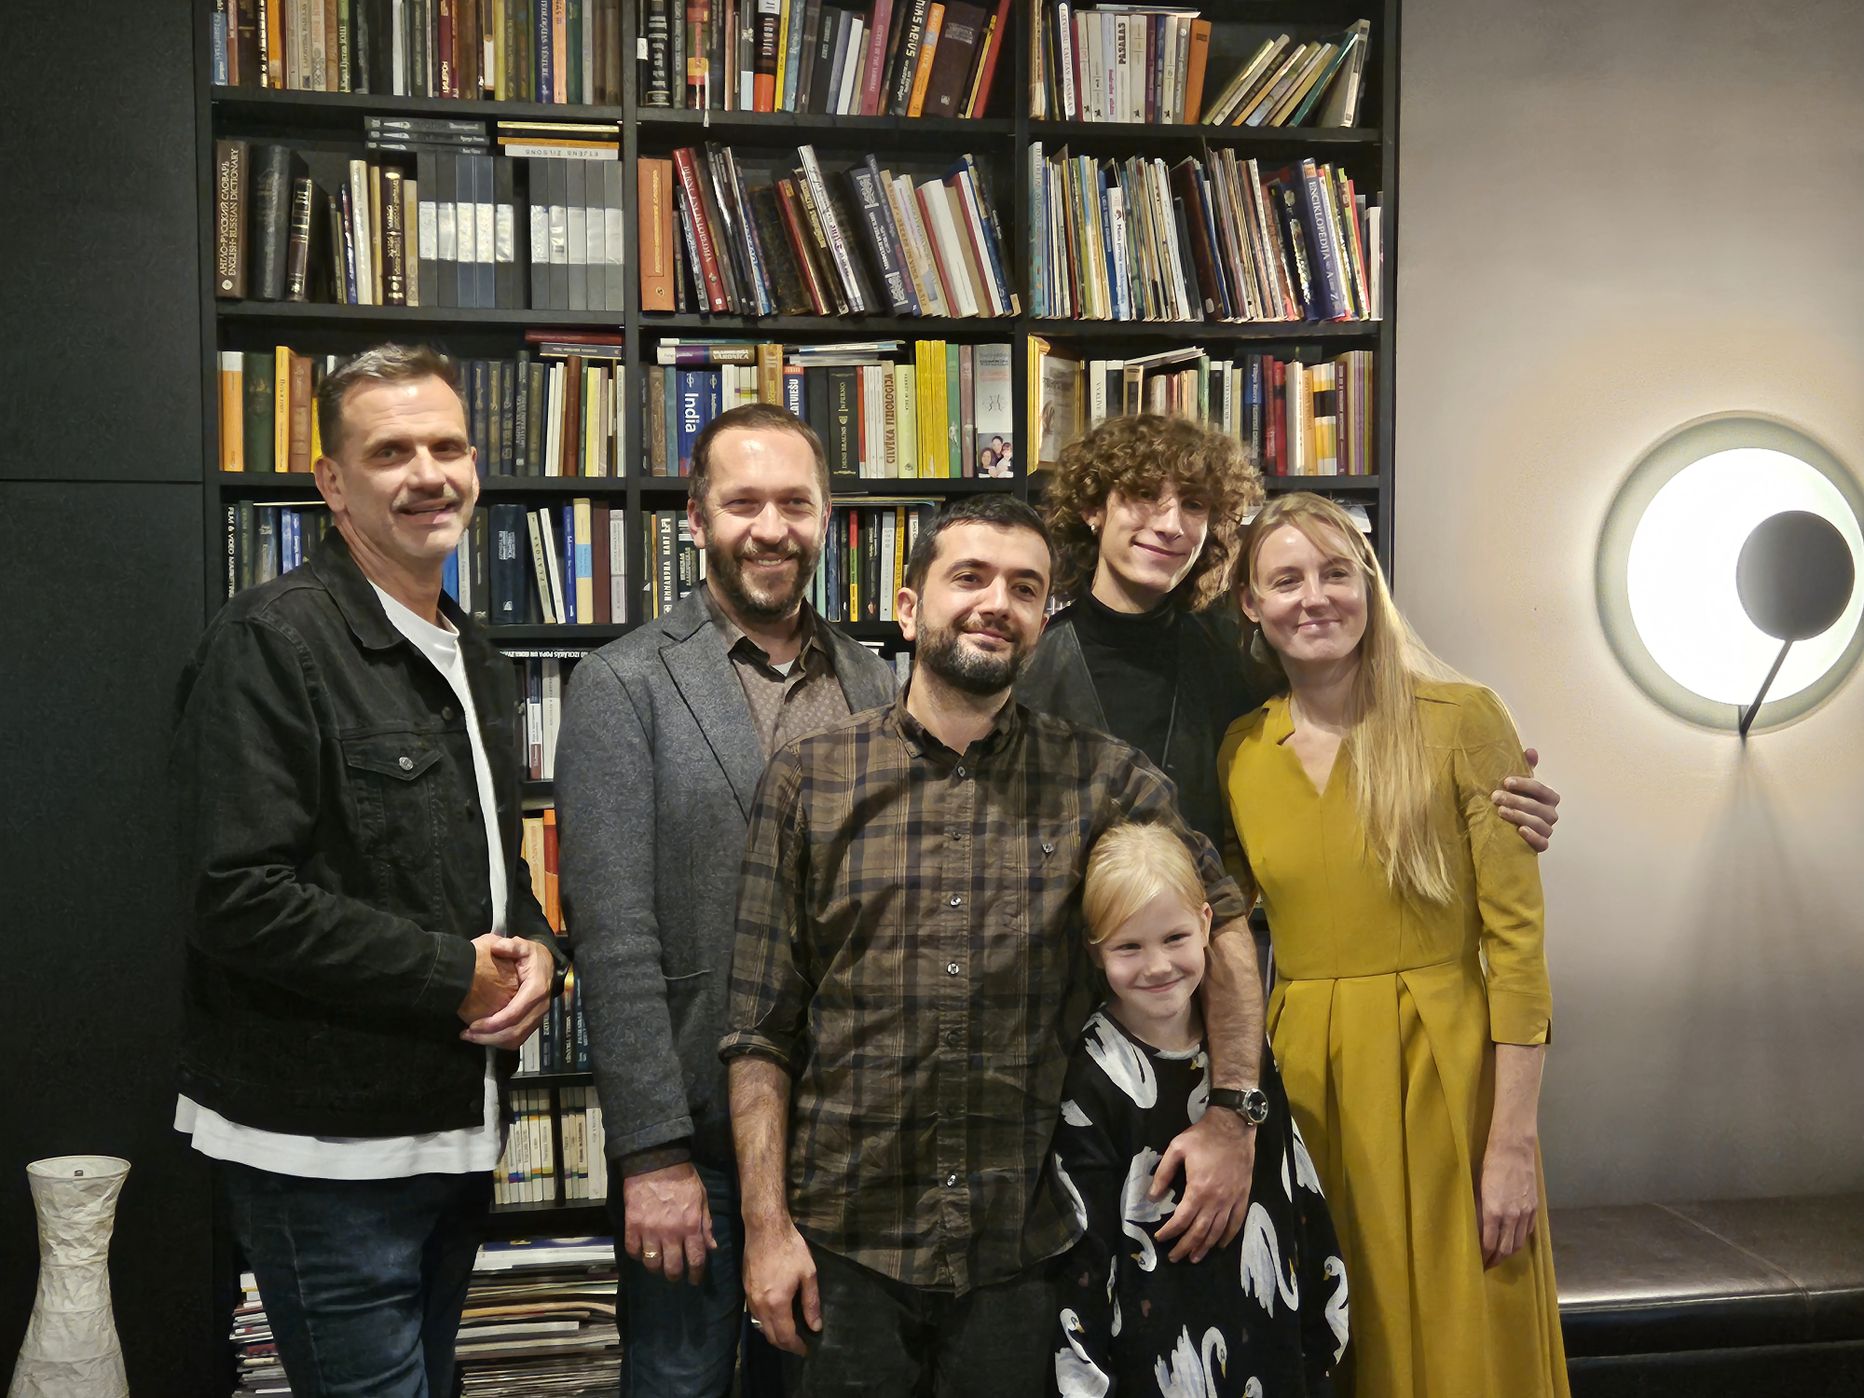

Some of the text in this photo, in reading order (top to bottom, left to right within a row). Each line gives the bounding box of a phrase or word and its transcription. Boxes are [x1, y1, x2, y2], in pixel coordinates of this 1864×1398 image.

[230, 148, 239, 200] DICTIONARY
[219, 161, 230, 276] АНГЛО-РУССКИЙ СЛОВАРЬ
[1329, 292, 1339, 301] Z
[684, 392, 700, 433] India
[884, 429, 896, 464] CILVĒKA
